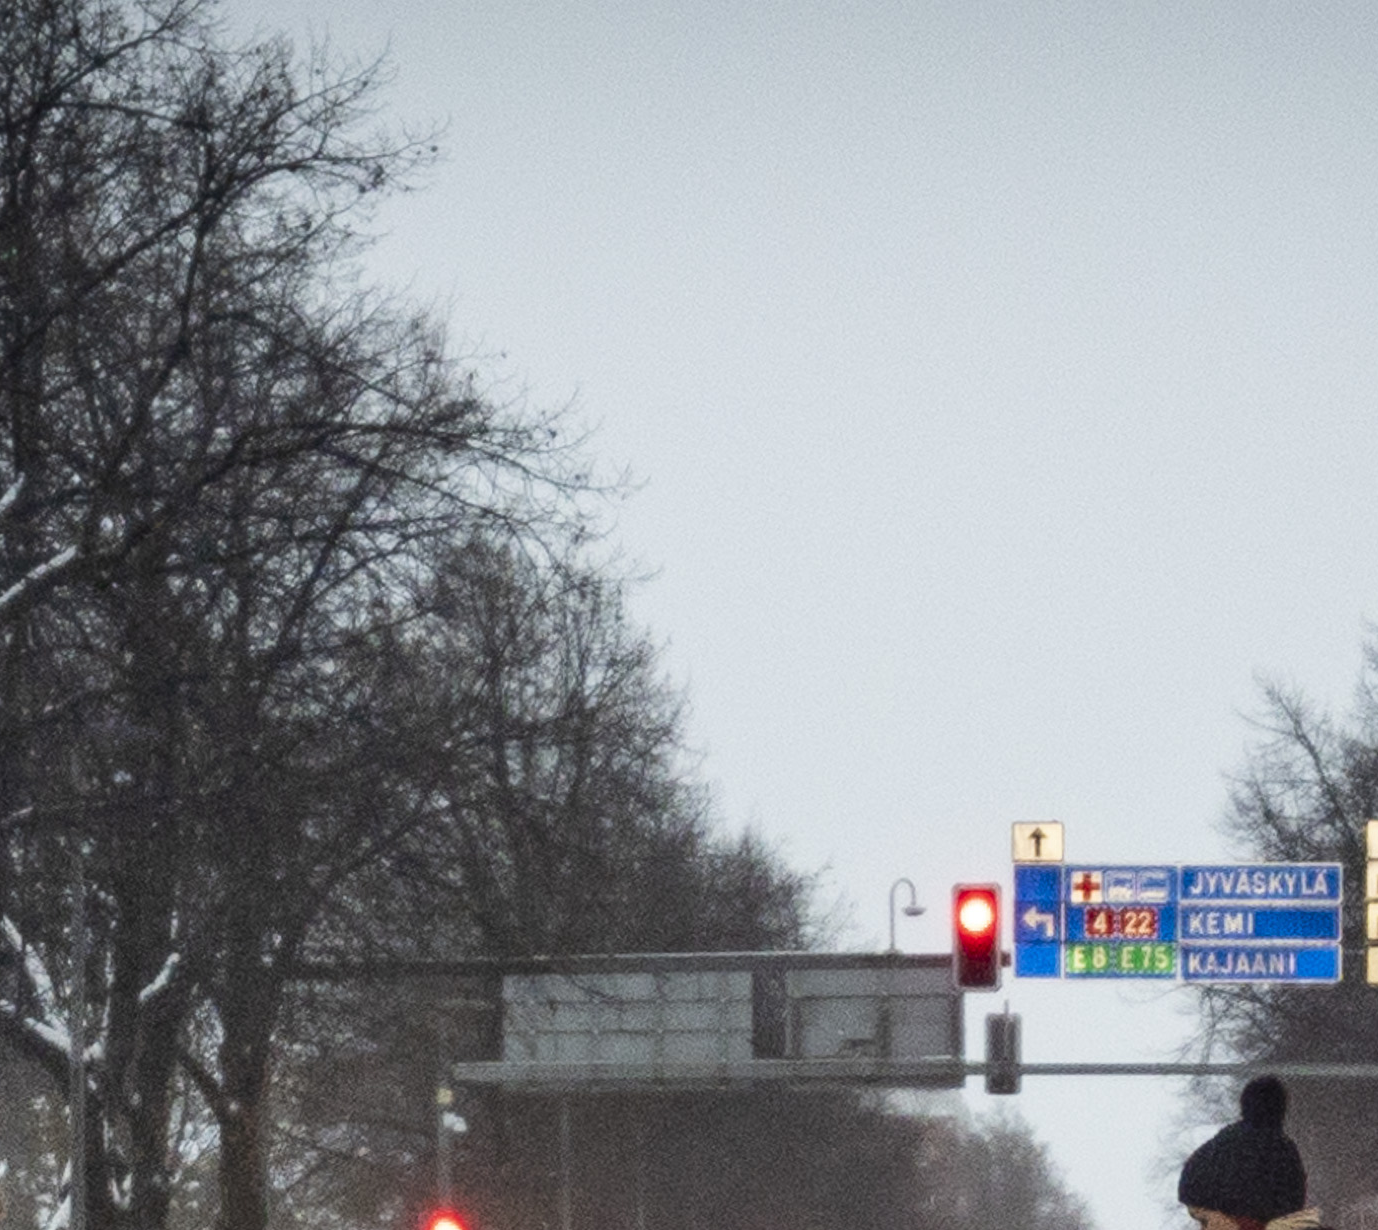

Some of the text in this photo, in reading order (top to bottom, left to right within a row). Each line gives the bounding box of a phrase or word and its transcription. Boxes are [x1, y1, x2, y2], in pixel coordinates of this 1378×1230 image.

[1190, 868, 1329, 895] JYVÄSKYLÄ
[1092, 911, 1108, 934] 4
[1124, 911, 1154, 935] 22
[1188, 911, 1254, 935] KEMI
[1074, 946, 1107, 969] E 8
[1121, 946, 1170, 969] E 75
[1187, 951, 1296, 975] KAJAANI
